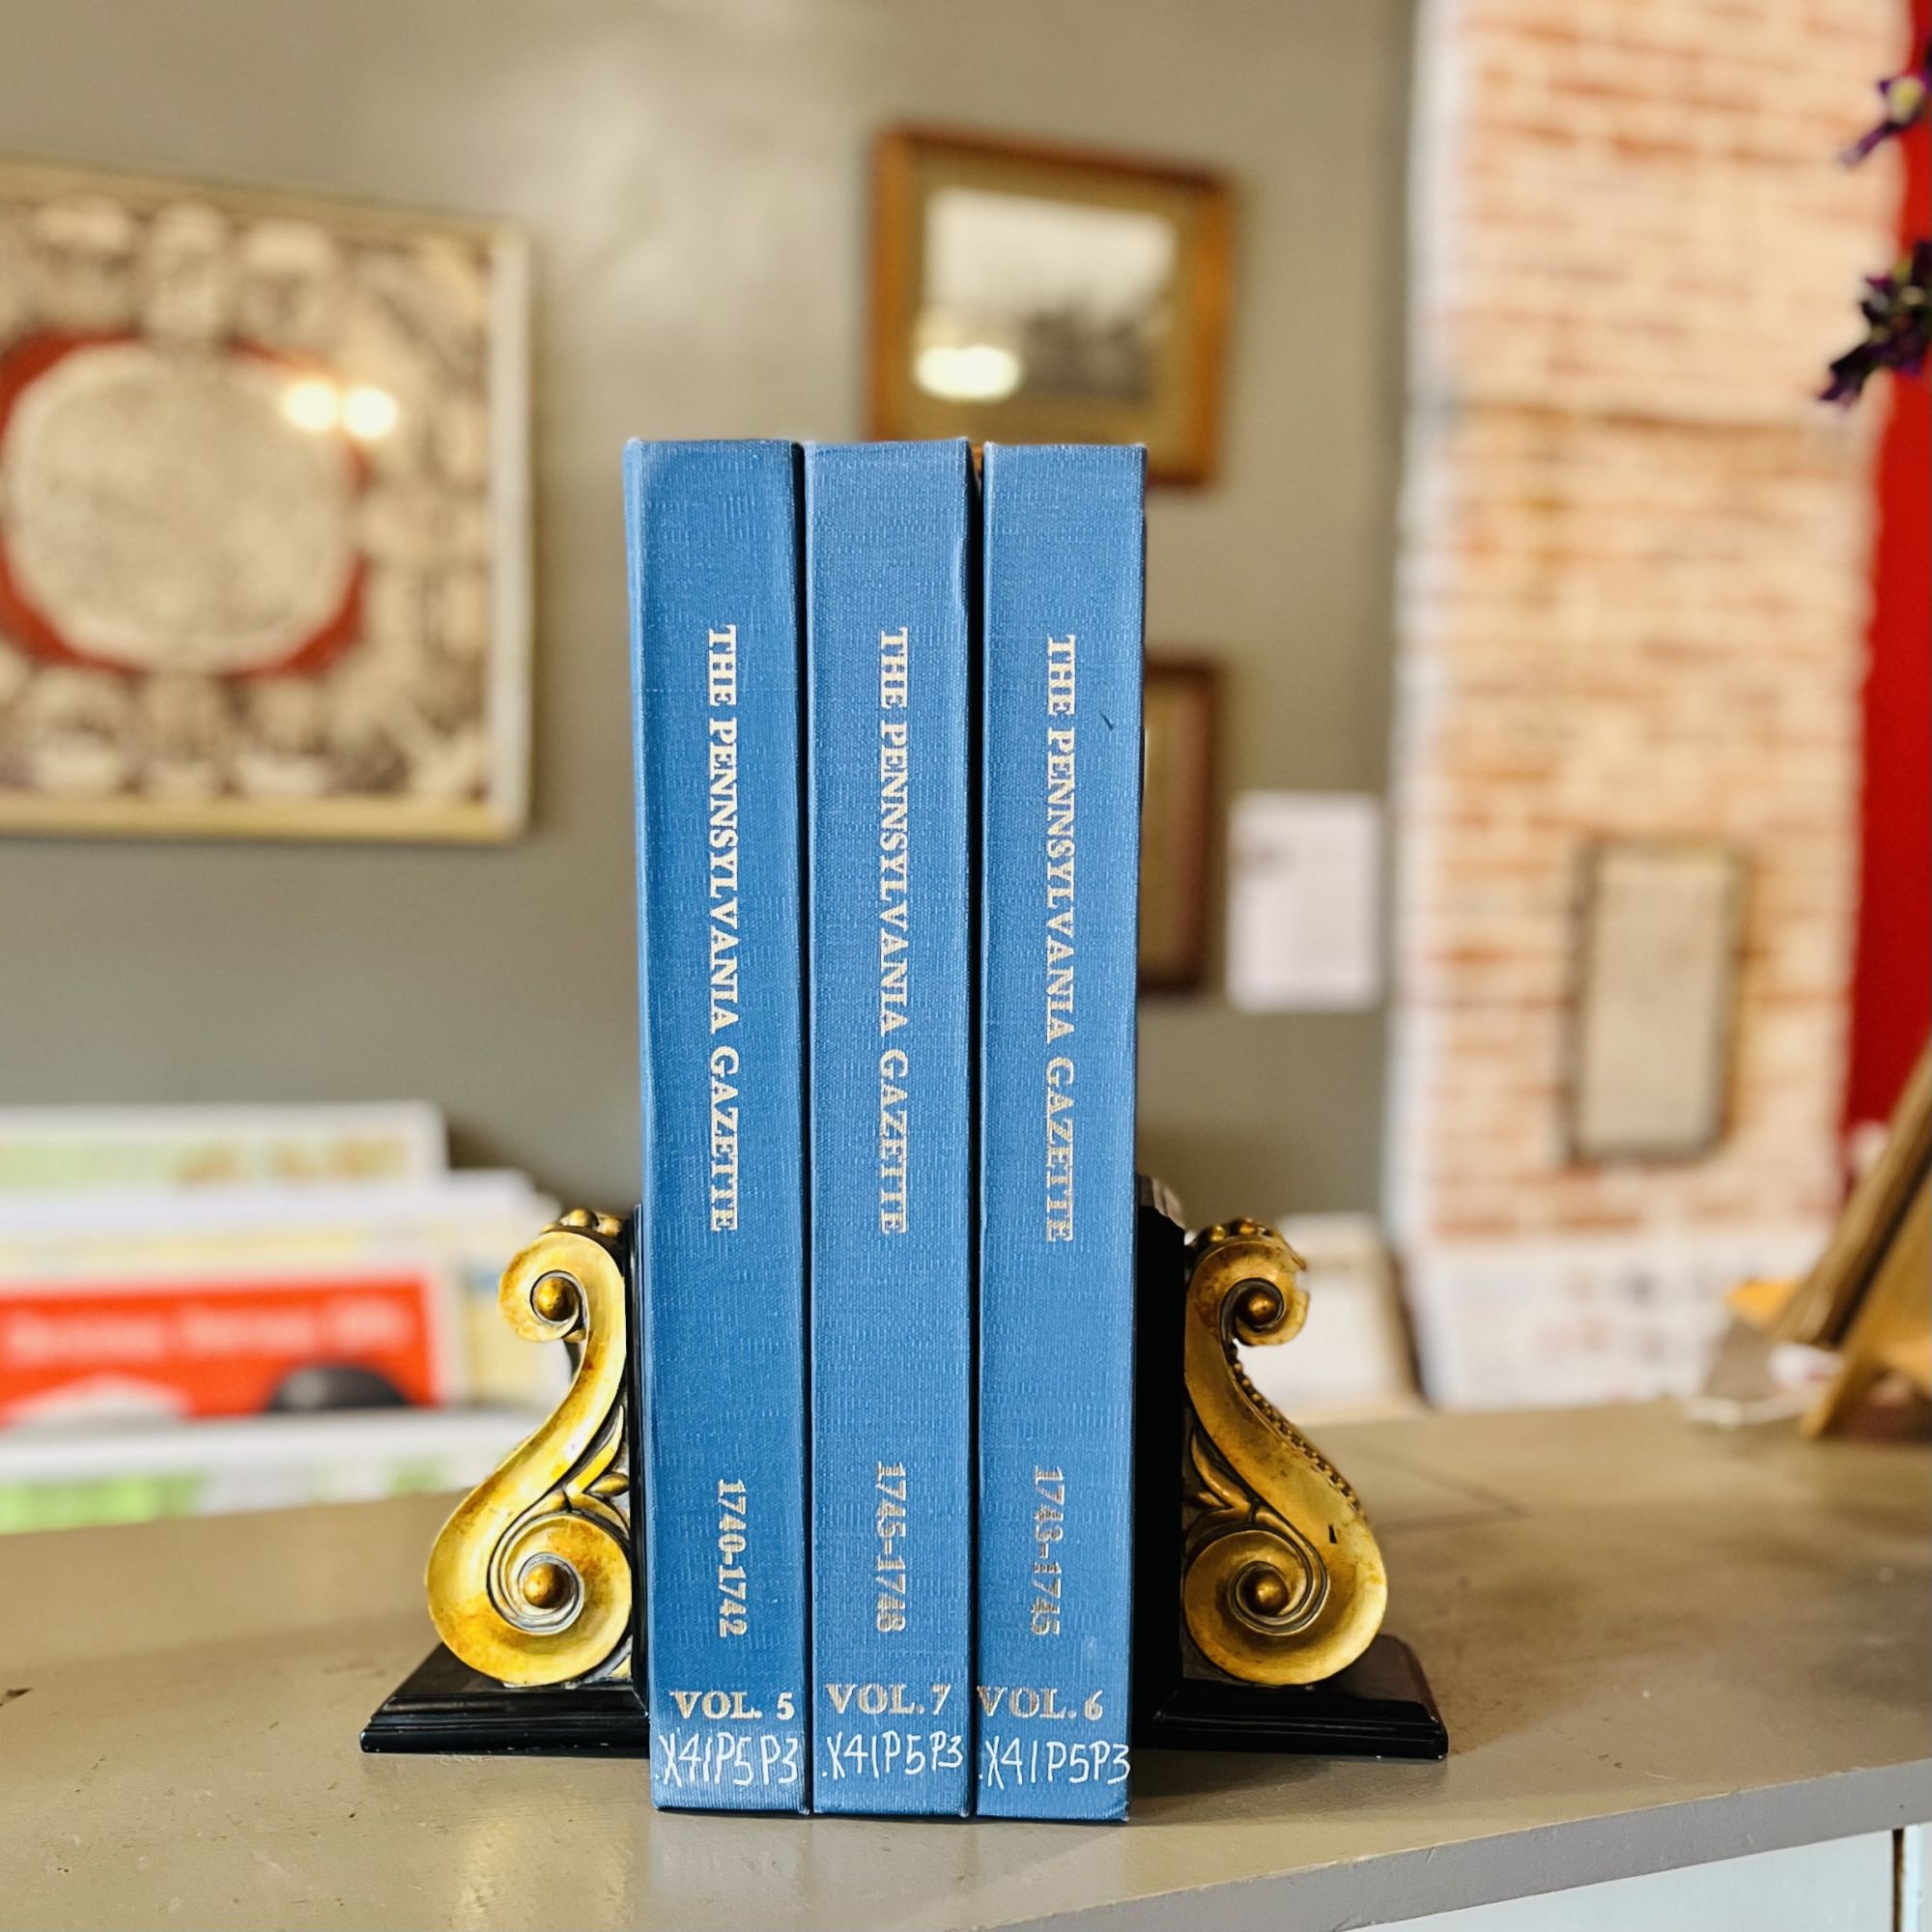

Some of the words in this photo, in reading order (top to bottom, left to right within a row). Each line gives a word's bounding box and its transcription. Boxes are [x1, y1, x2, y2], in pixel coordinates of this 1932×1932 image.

[708, 625, 738, 706] THE
[880, 627, 909, 708] THE
[1045, 635, 1076, 715] THE
[708, 718, 738, 1034] PENNSYLVANIA
[880, 720, 909, 1037] PENNSYLVANIA
[1045, 726, 1076, 1043] PENNSYLVANIA
[710, 1045, 740, 1233] GAZETTE
[880, 1048, 909, 1234] GAZETTE
[1045, 1056, 1076, 1242] GAZETTE
[718, 1479, 748, 1638] 1740-1742
[875, 1461, 906, 1633] 1745-1748
[1031, 1464, 1065, 1636] 1743-1745
[776, 1691, 795, 1720] 5
